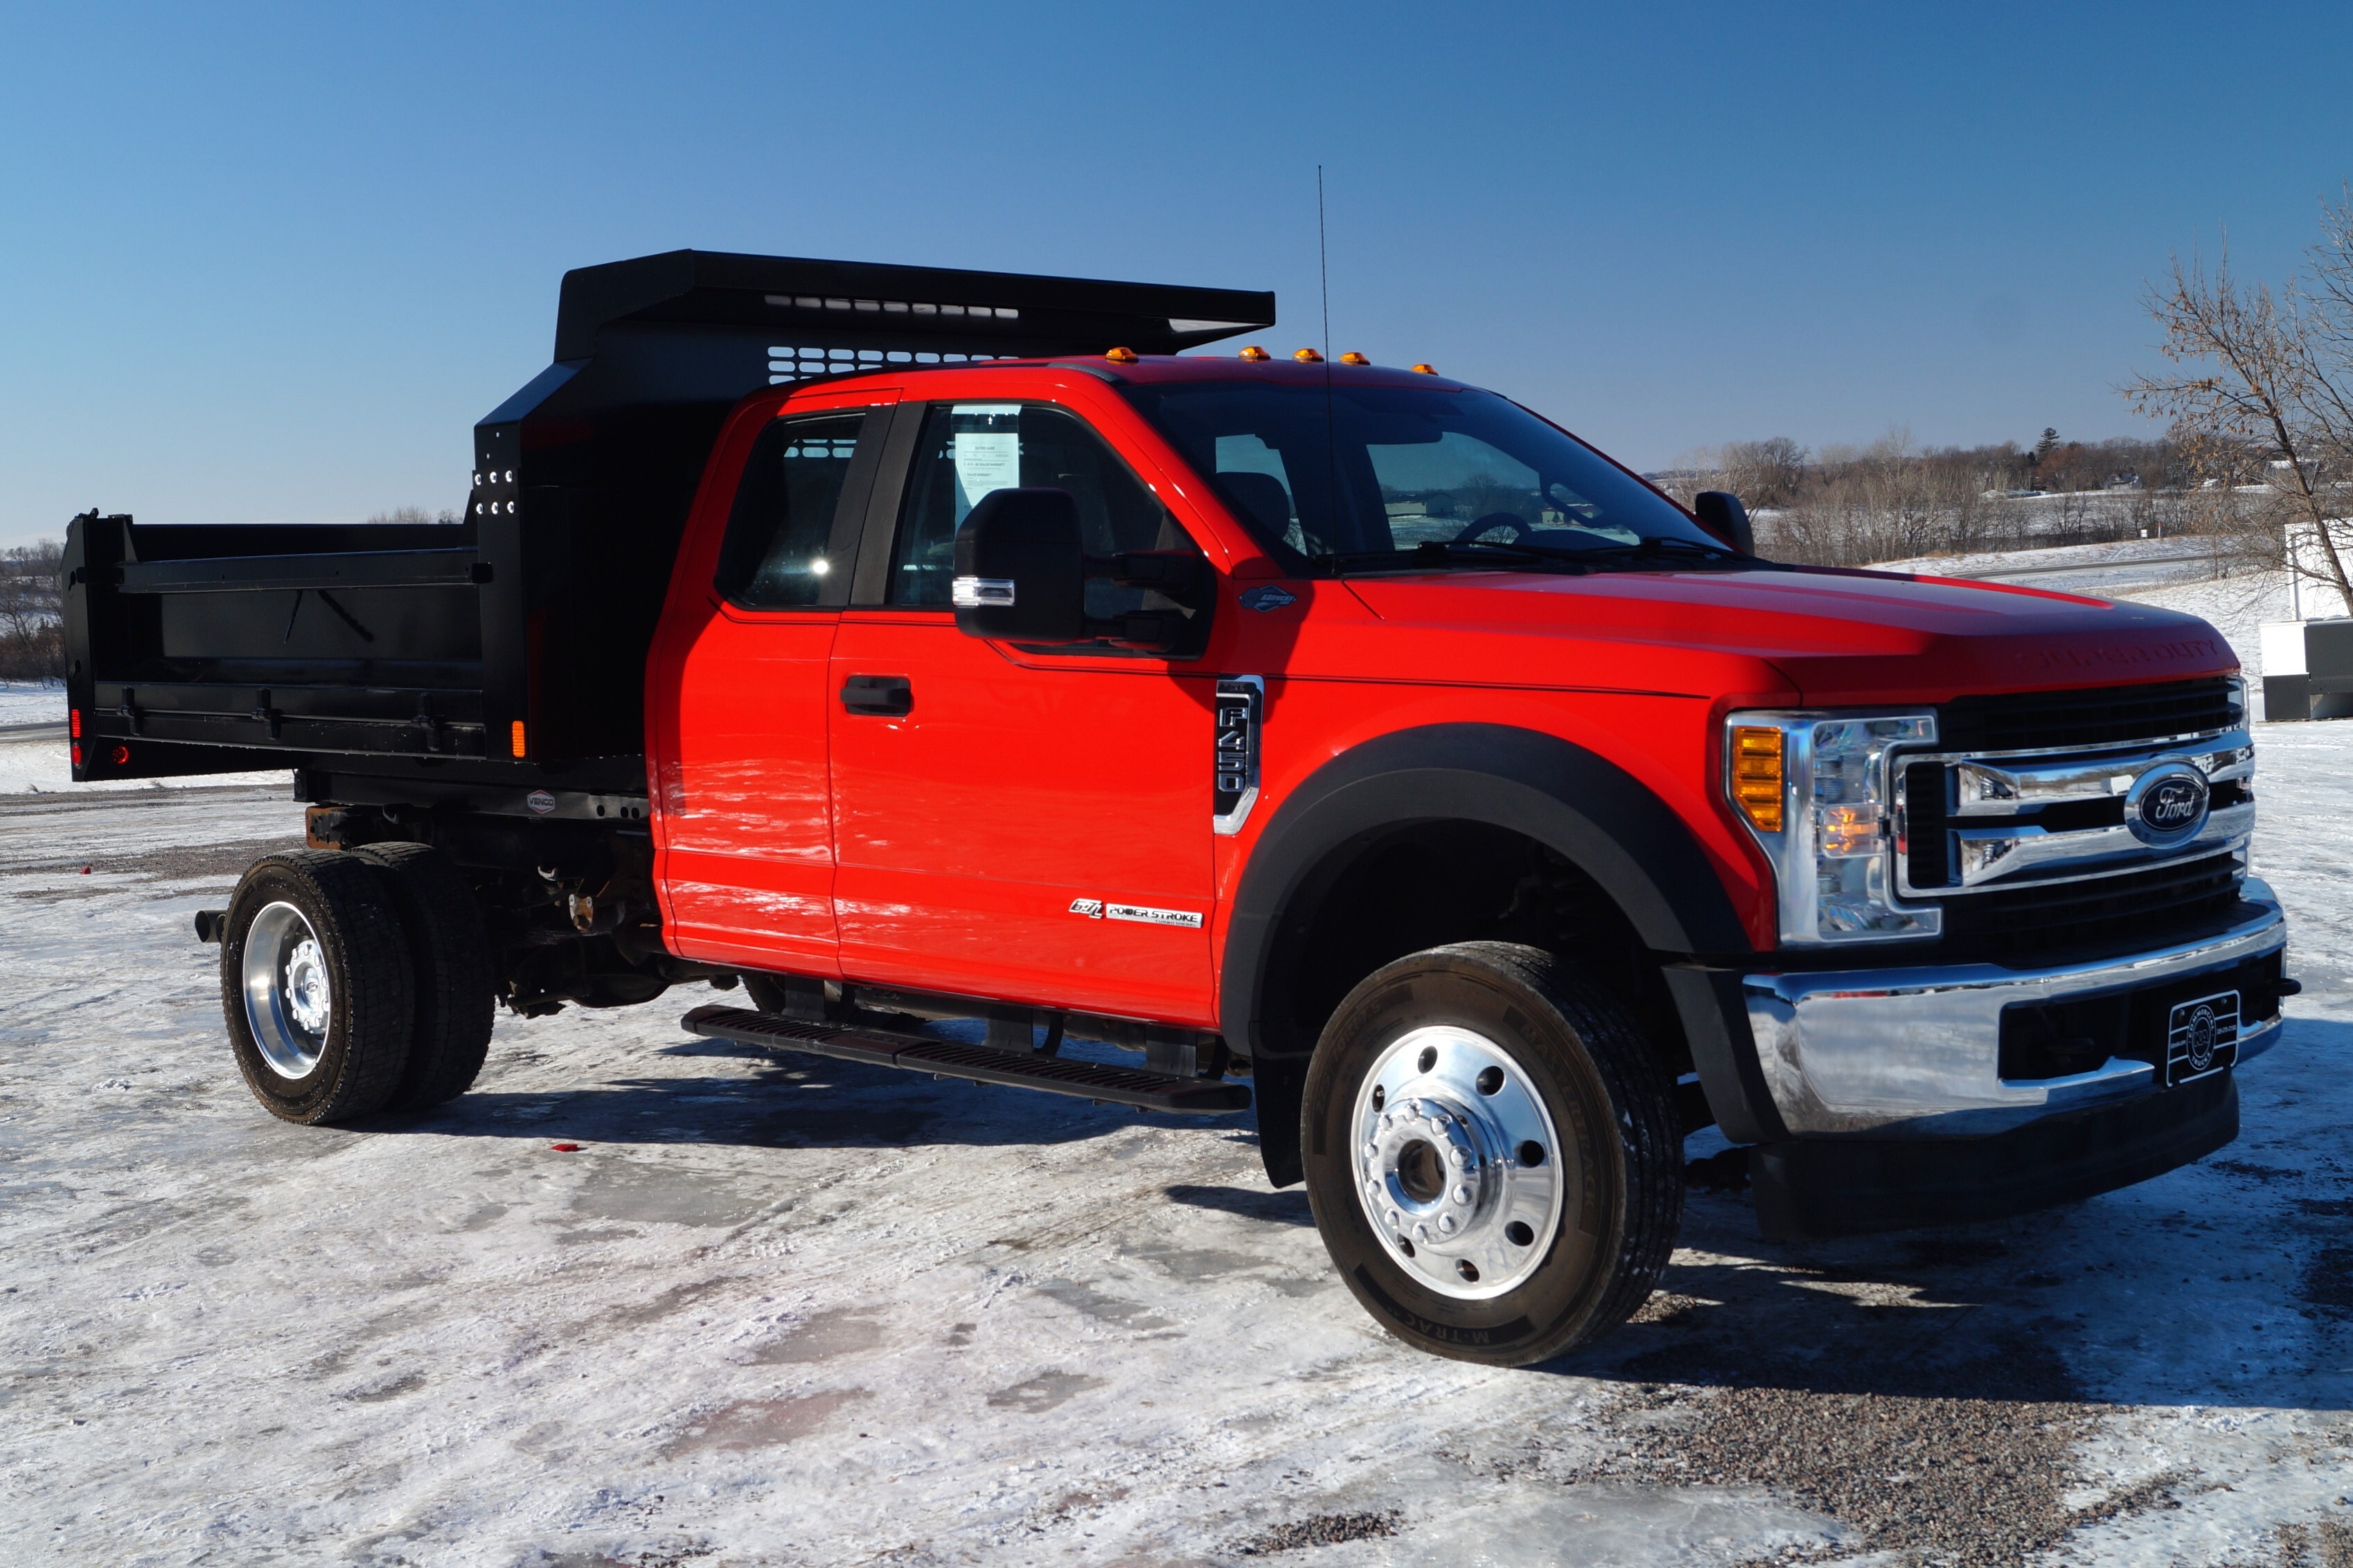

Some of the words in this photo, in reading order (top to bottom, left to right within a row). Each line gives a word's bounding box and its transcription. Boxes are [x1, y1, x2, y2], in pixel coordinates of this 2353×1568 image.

[529, 797, 554, 807] VENCO
[2155, 786, 2195, 820] Ford
[1109, 906, 1148, 918] POWER
[1151, 911, 1198, 923] STROKE
[2188, 1008, 2214, 1038] COMMERCIAL
[2192, 1051, 2211, 1067] TRUCKS
